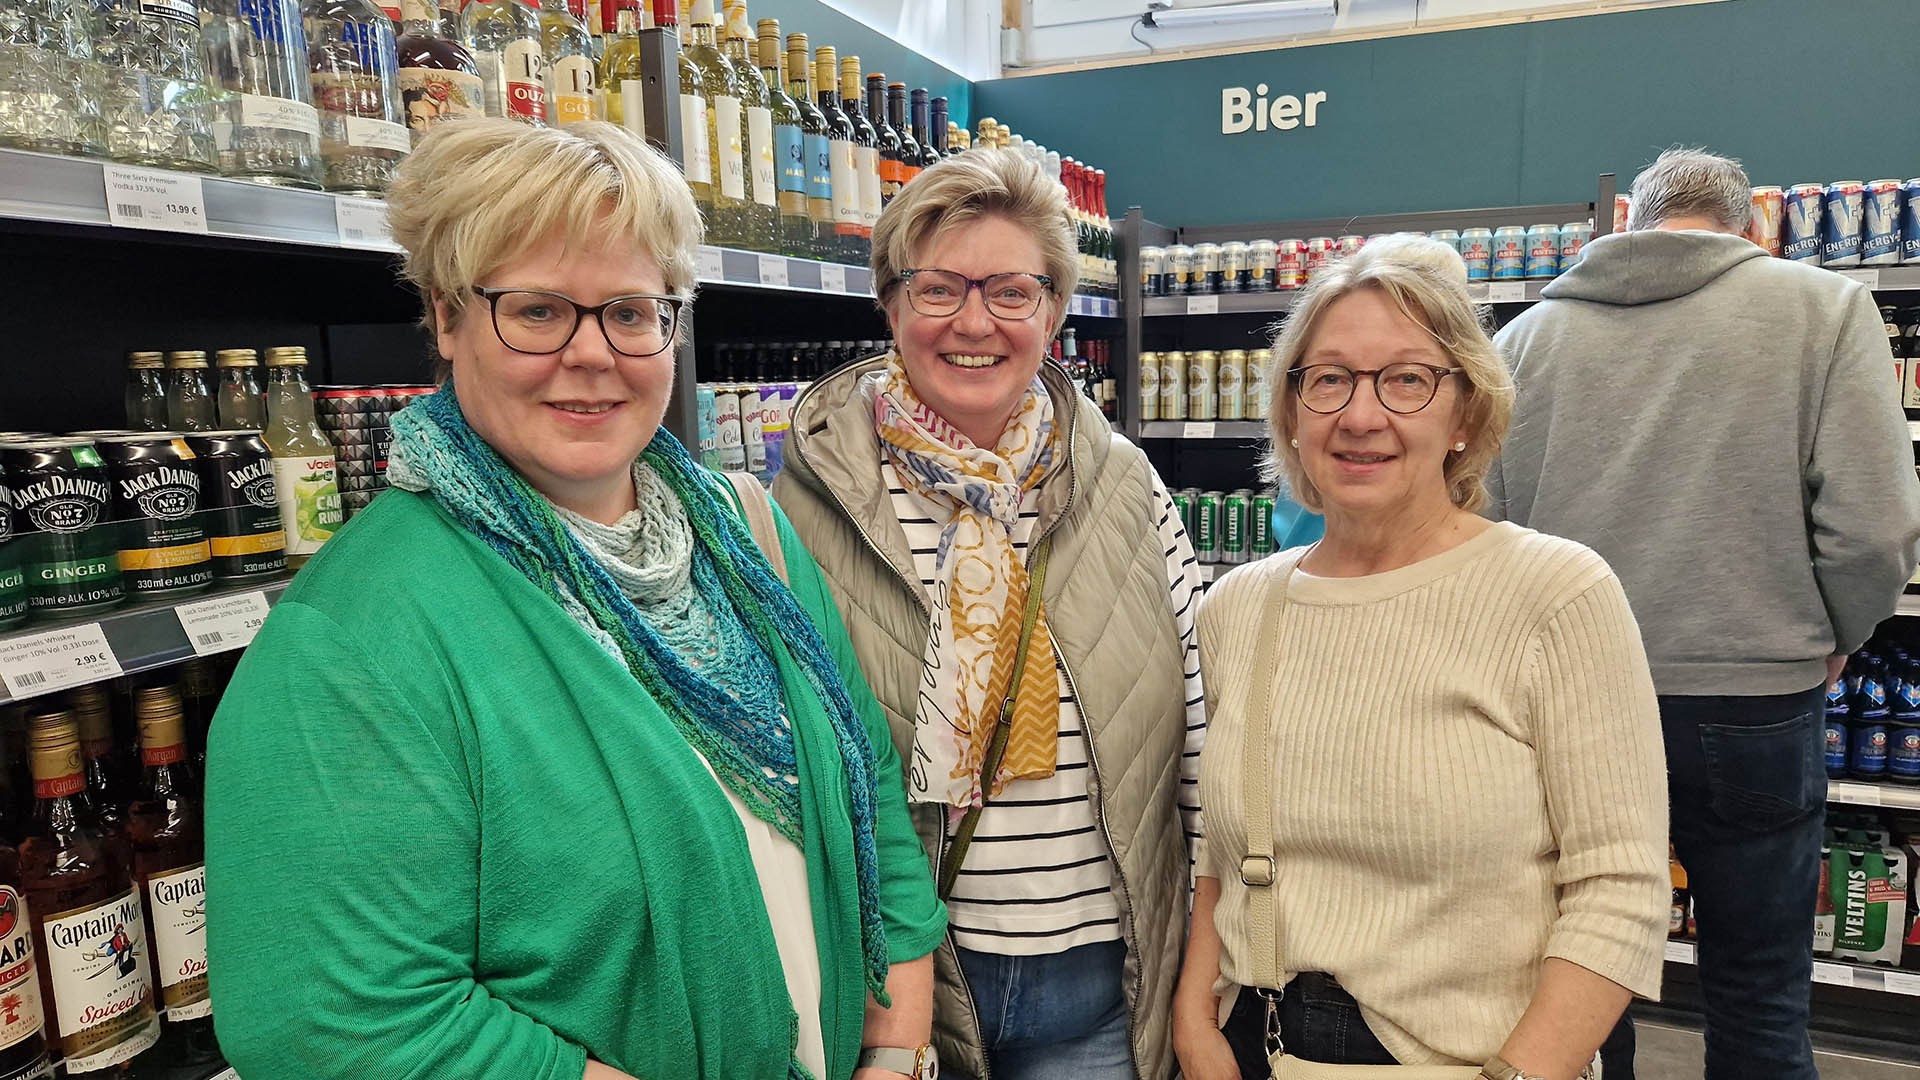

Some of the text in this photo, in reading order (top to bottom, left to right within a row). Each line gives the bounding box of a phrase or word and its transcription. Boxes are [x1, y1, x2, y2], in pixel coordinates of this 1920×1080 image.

[1221, 83, 1327, 135] Bier
[112, 171, 131, 180] Three
[149, 175, 178, 185] Premium
[112, 182, 134, 191] Vodka
[136, 184, 155, 193] 37,5%
[166, 203, 198, 215] 13,99 €
[1464, 251, 1489, 260] ASTRA
[1498, 250, 1522, 259] ASTRA
[1533, 248, 1557, 257] ASTRA
[227, 463, 261, 489] JACK
[12, 475, 108, 510] JACK DANIEL'S
[120, 472, 160, 499] JACK
[54, 518, 81, 526] BRAND
[1200, 505, 1210, 540] VELTINS
[1228, 506, 1238, 541] VELTINS
[1256, 506, 1266, 542] VELTINS
[41, 563, 107, 580] GINGER
[190, 572, 206, 583] 10%
[67, 594, 87, 604] ALK.
[88, 589, 110, 601] 10%
[187, 613, 220, 625] Lemonade
[244, 618, 262, 629] 2,99
[16, 639, 45, 650] Daniels
[44, 633, 76, 645] Whiskey
[3, 652, 29, 664] Ginger
[30, 649, 46, 658] 10%
[82, 638, 99, 648] Dose
[74, 654, 98, 667] 2,99
[98, 652, 107, 661] €
[154, 871, 206, 906] Captai
[1844, 870, 1867, 937] VELTINS
[51, 911, 117, 950] Captain
[79, 990, 137, 1024] Spiced
